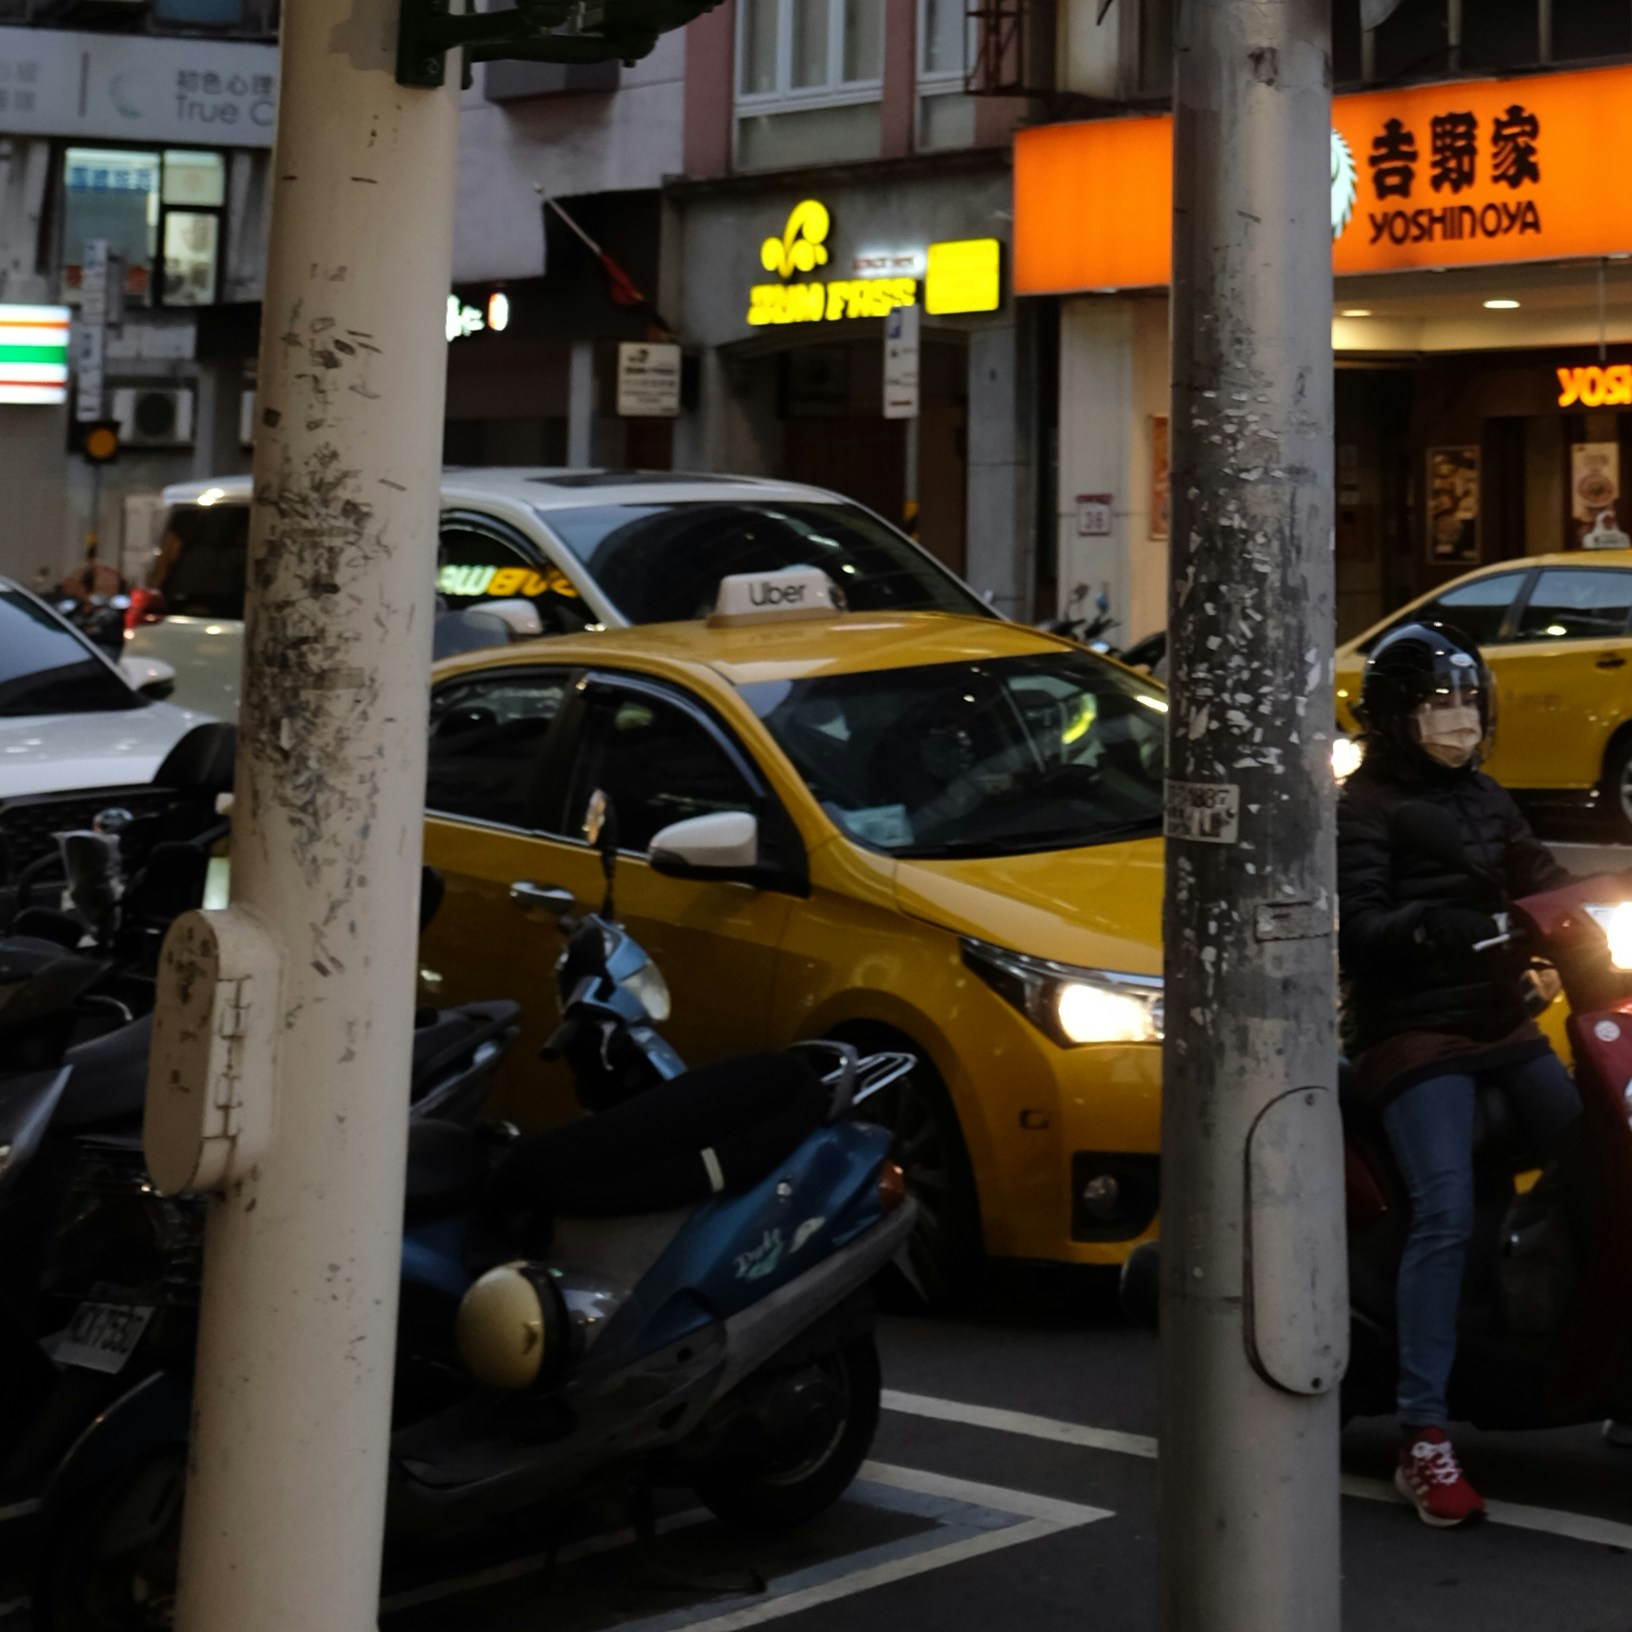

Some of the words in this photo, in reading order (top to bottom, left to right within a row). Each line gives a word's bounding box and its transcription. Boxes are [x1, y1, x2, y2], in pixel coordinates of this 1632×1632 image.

[175, 93, 240, 126] True
[1367, 199, 1542, 246] YOSHINOYA
[748, 579, 808, 608] Uber
